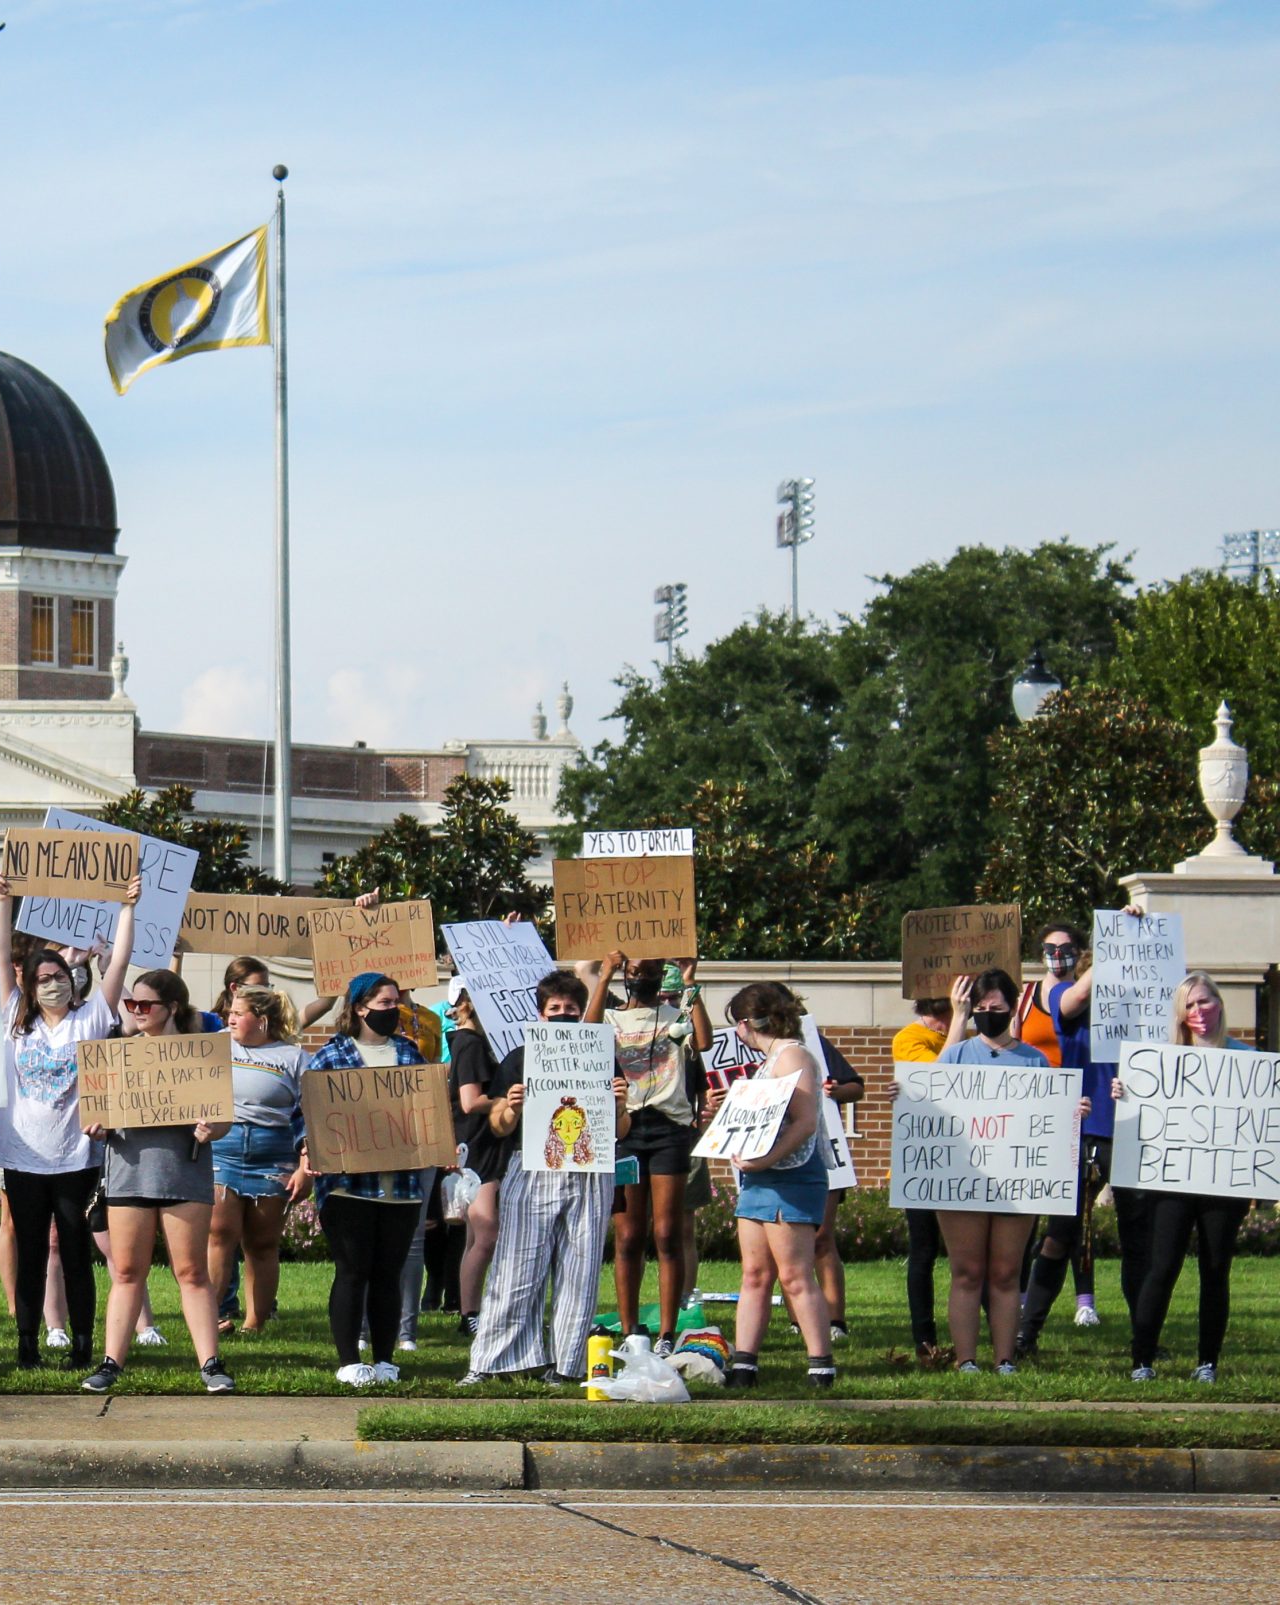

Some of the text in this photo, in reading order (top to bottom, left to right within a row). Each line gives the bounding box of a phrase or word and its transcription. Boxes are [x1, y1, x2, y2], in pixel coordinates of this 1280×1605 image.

[589, 829, 691, 854] YES TO FORMAL
[6, 840, 29, 877] NO
[35, 840, 101, 881] MEANS
[104, 842, 132, 882] NO
[584, 858, 657, 889] STOP
[562, 888, 684, 918] FRATERNITY
[181, 907, 219, 932] NOT
[224, 910, 250, 935] ON
[257, 912, 290, 939] OUR
[313, 909, 356, 935] BOYS
[360, 907, 404, 928] WILL
[565, 917, 688, 947] RAPE CULTURE
[906, 911, 1015, 938] PROTECT YOUR
[1096, 914, 1168, 938] WE ARE
[446, 921, 516, 949] I STILL
[923, 955, 952, 969] NOT
[1096, 941, 1174, 963] SOUTHERN
[466, 971, 507, 992] WHAT
[1122, 964, 1163, 983] MISS,
[1096, 984, 1127, 999] AND
[1133, 986, 1156, 999] WE
[1098, 1001, 1168, 1019] BETTER
[555, 1028, 572, 1042] ONE
[579, 1028, 599, 1041] CAN
[1091, 1024, 1129, 1041] THAN
[82, 1040, 214, 1070] RAPE SHOULD
[569, 1040, 606, 1056] BECOME
[85, 1073, 118, 1092] NOT
[172, 1066, 204, 1085] PART
[209, 1066, 225, 1079] OF
[542, 1058, 581, 1074] BETTER
[326, 1069, 431, 1103] NO MORE
[907, 1070, 1075, 1102] SEXUAL ASSAULT
[81, 1090, 177, 1112] THE COLLEGE
[140, 1102, 224, 1125] EXPERIENCE
[325, 1106, 441, 1155] SILENCE
[898, 1112, 1055, 1141] SHOULD NOT BE
[903, 1145, 1049, 1174] PART OF THE
[1138, 1144, 1280, 1188] BETTER
[903, 1177, 1073, 1203] COLLEGE EXPERIENCE
